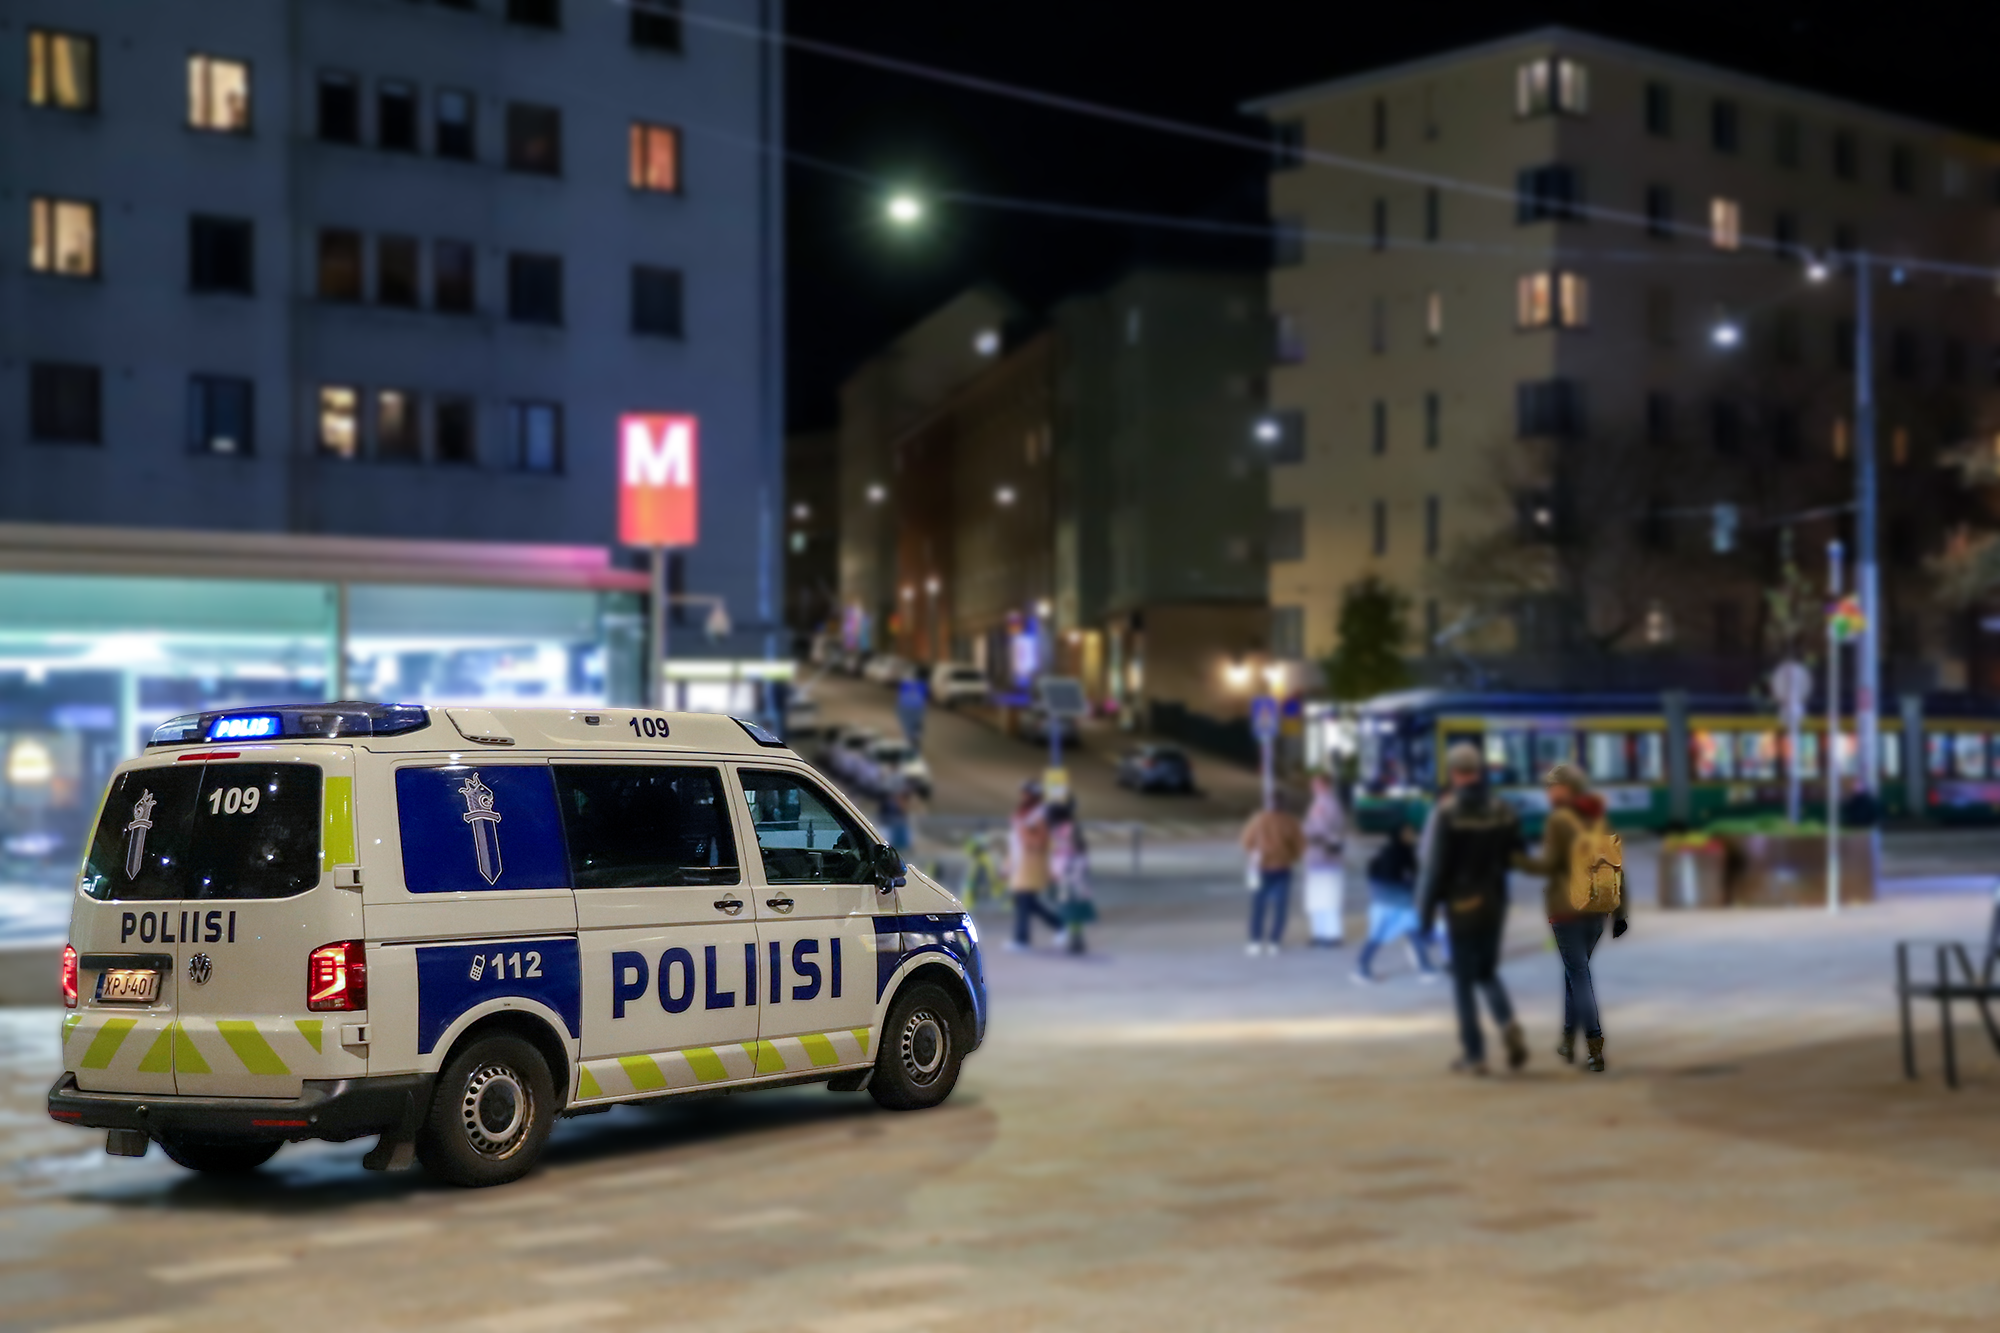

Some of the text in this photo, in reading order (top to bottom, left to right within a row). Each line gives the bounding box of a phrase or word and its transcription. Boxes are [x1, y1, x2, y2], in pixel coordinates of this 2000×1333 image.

[625, 424, 692, 487] M
[215, 717, 270, 738] POLIS
[629, 716, 670, 738] 109
[209, 787, 259, 815] 109
[121, 910, 236, 943] POLIISI
[491, 951, 543, 980] 112
[612, 938, 842, 1019] POLIISI
[104, 975, 154, 996] XPJ-401
